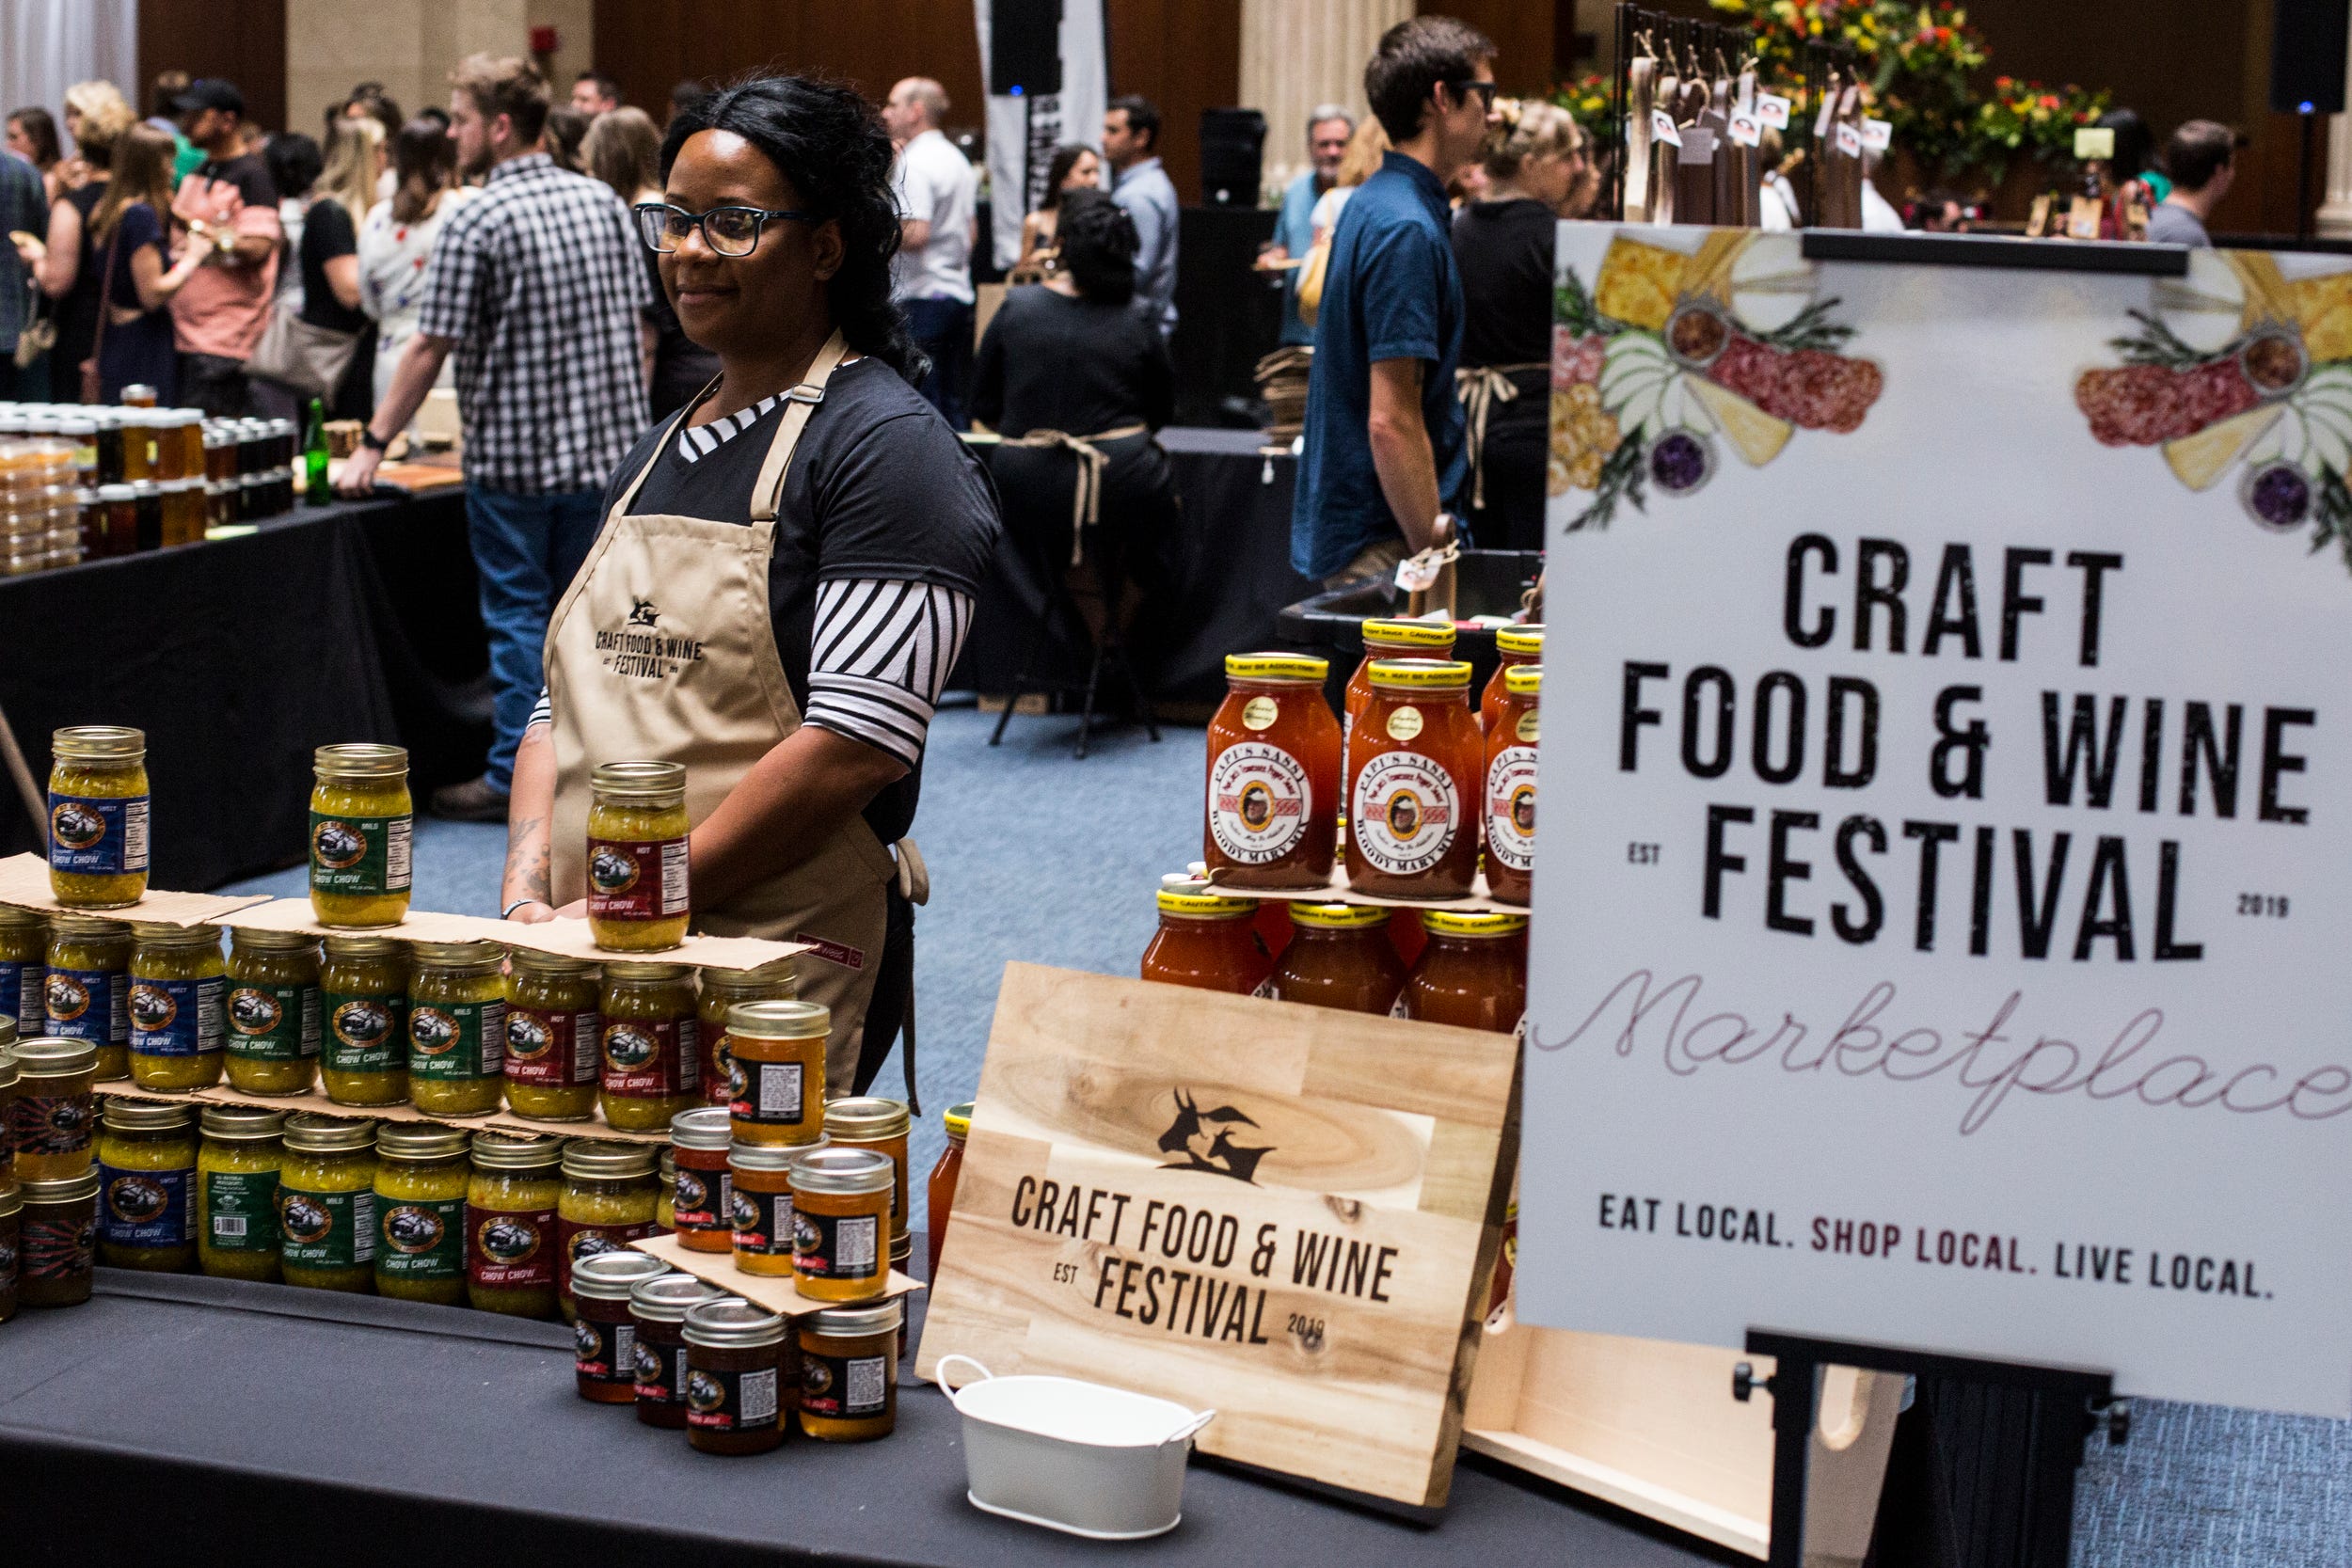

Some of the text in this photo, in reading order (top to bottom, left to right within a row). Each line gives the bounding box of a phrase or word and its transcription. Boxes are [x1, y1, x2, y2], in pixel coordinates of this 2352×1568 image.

[1781, 531, 2124, 668] CRAFT
[596, 630, 703, 660] CRAFT FOOD & WINE
[613, 655, 664, 678] FESTIVAL
[1619, 659, 2317, 826] FOOD & WINE
[1262, 747, 1305, 783] SASSY
[1409, 755, 1453, 790] SASSY
[1213, 810, 1243, 859] BLOODY
[1248, 845, 1287, 863] MARY
[1357, 819, 1391, 868] BLOODY
[1397, 853, 1437, 871] MARY
[72, 855, 99, 863] CHOW
[333, 875, 360, 883] CHOW
[1628, 803, 2290, 963] EST FESTIVAL 2019
[608, 900, 635, 910] CHOW
[59, 1026, 84, 1035] CHOW
[146, 1037, 171, 1046] CHOW
[248, 1040, 276, 1050] CHOW
[336, 1052, 390, 1064] CHOW CHOW
[1531, 969, 2352, 1135] Marketplace
[429, 1060, 455, 1069] CHOW
[521, 1066, 548, 1075] CHOW
[627, 1077, 654, 1087] CHOW
[134, 1227, 162, 1237] CHOW
[1011, 1176, 1399, 1303] CRAFT FOOD & WINE
[1597, 1193, 2275, 1301] EAT LOCAL. SHOP LOCAL. LIVE LOCAL.
[301, 1248, 327, 1259] CHOW
[386, 1258, 438, 1269] CHOW CHOW
[481, 1269, 535, 1280] CHOW CHOW
[1053, 1262, 1078, 1286] EST
[1094, 1256, 1269, 1345] FESTIVAL
